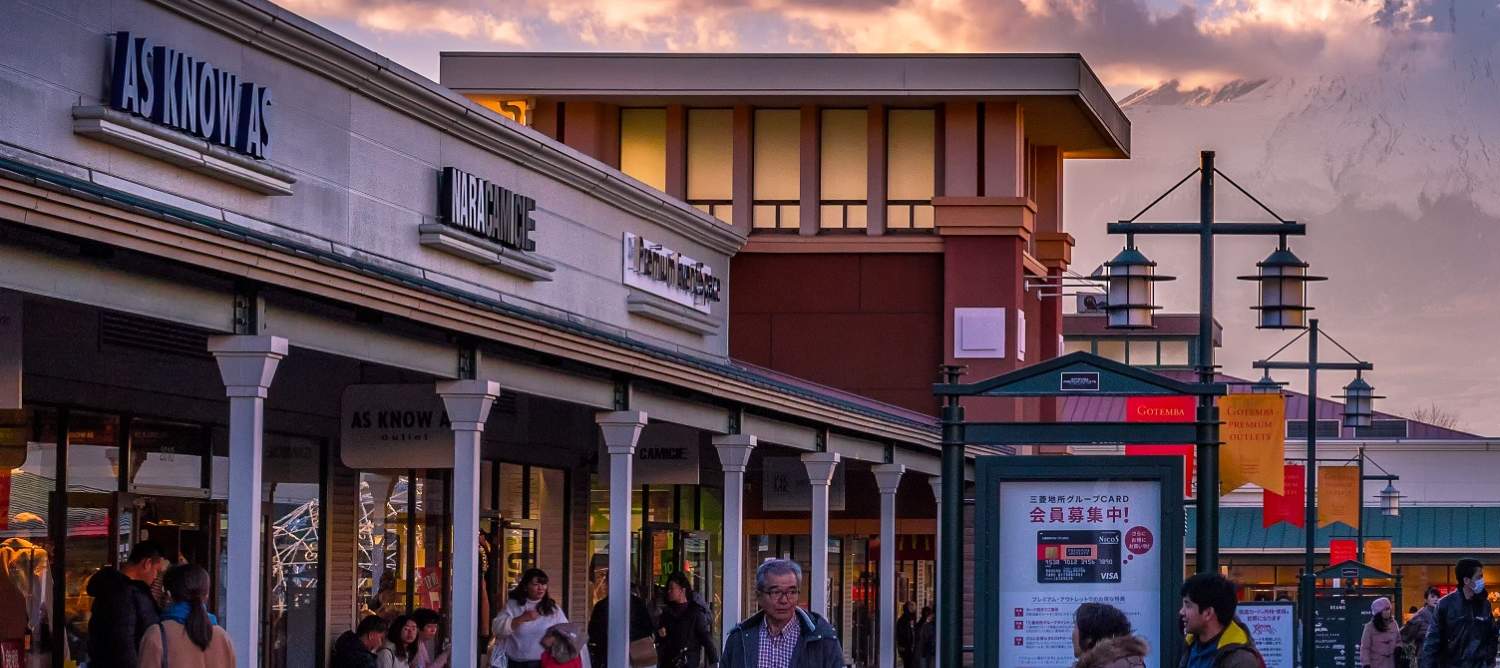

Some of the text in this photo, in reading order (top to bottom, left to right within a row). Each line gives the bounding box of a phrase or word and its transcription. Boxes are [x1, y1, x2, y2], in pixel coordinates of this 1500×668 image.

[117, 31, 272, 160] AS KNOW AS
[1137, 406, 1185, 416] GOTEMBA
[1227, 406, 1274, 416] GOTEMBA
[351, 411, 372, 428] AS
[378, 411, 433, 428] KNOW
[1228, 420, 1273, 428] PREMIUM
[1229, 432, 1272, 441] OUTLETS
[1029, 506, 1129, 523] 会員募集中!
[1101, 572, 1119, 580] VISA
